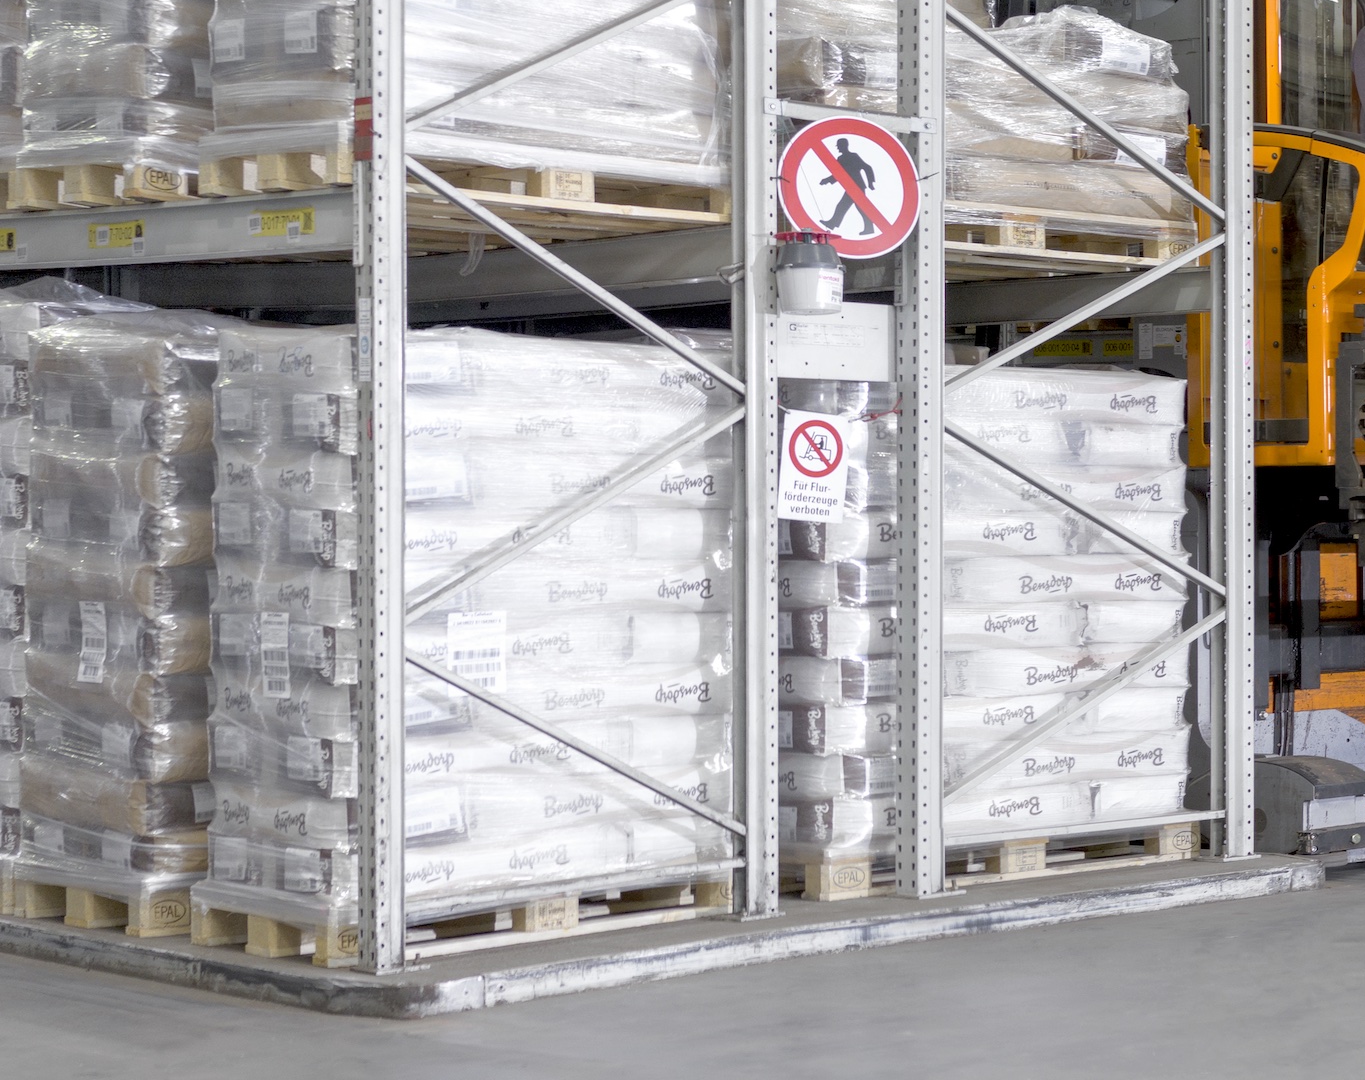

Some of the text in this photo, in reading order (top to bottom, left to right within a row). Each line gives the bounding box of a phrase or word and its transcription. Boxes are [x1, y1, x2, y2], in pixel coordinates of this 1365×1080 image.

[150, 169, 178, 187] EPAL
[1110, 393, 1158, 414] Bensdorp
[661, 474, 717, 497] Bensdorp
[793, 479, 831, 493] Für Flur-
[1115, 482, 1163, 502] Bensdorp
[784, 492, 838, 507] förderzeuge
[790, 505, 830, 517] verboten
[983, 521, 1037, 541] Bensdorp
[657, 577, 714, 600] Bensdorp
[1019, 574, 1073, 594] Bensdorp
[1115, 573, 1163, 592] Bensdorp
[984, 614, 1039, 633] Bensdorp
[512, 632, 574, 656] Bensdorp
[1023, 664, 1079, 686] Bensdorp
[655, 681, 712, 705] Bensdorp
[983, 705, 1037, 725] Bensdorp
[1022, 756, 1076, 777] Bensdorp
[1118, 747, 1165, 767] Bensdorp
[544, 792, 604, 818] Bensdorp
[988, 795, 1043, 817] Bensdorp
[1176, 833, 1195, 848] EPAL
[509, 842, 570, 869] Bensdorp
[837, 866, 862, 885] EPAL
[154, 906, 180, 920] EPAL
